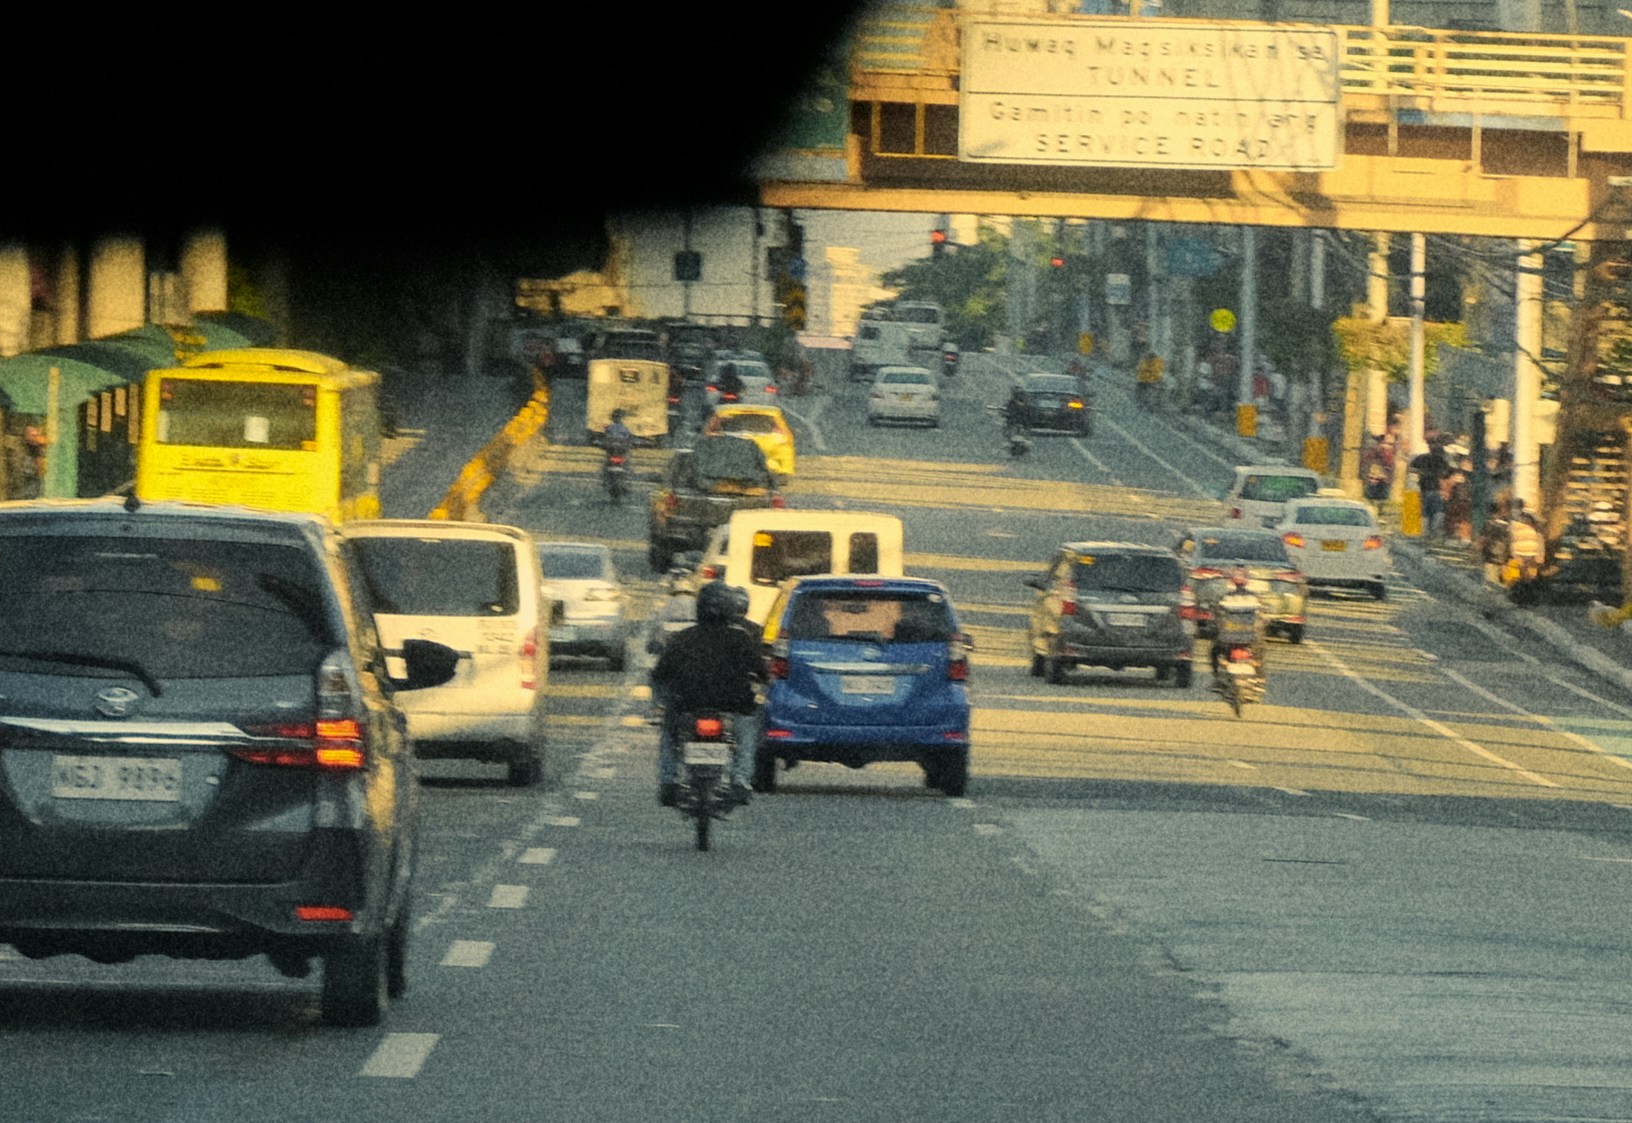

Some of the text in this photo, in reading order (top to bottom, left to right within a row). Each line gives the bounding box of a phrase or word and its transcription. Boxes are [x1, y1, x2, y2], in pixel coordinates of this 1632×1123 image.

[981, 31, 1076, 60] Huwag
[1297, 43, 1327, 60] sa
[1087, 66, 1219, 88] TUNNEL
[991, 101, 1104, 124] Gamitin
[1036, 133, 1270, 159] SERVICE ROAD
